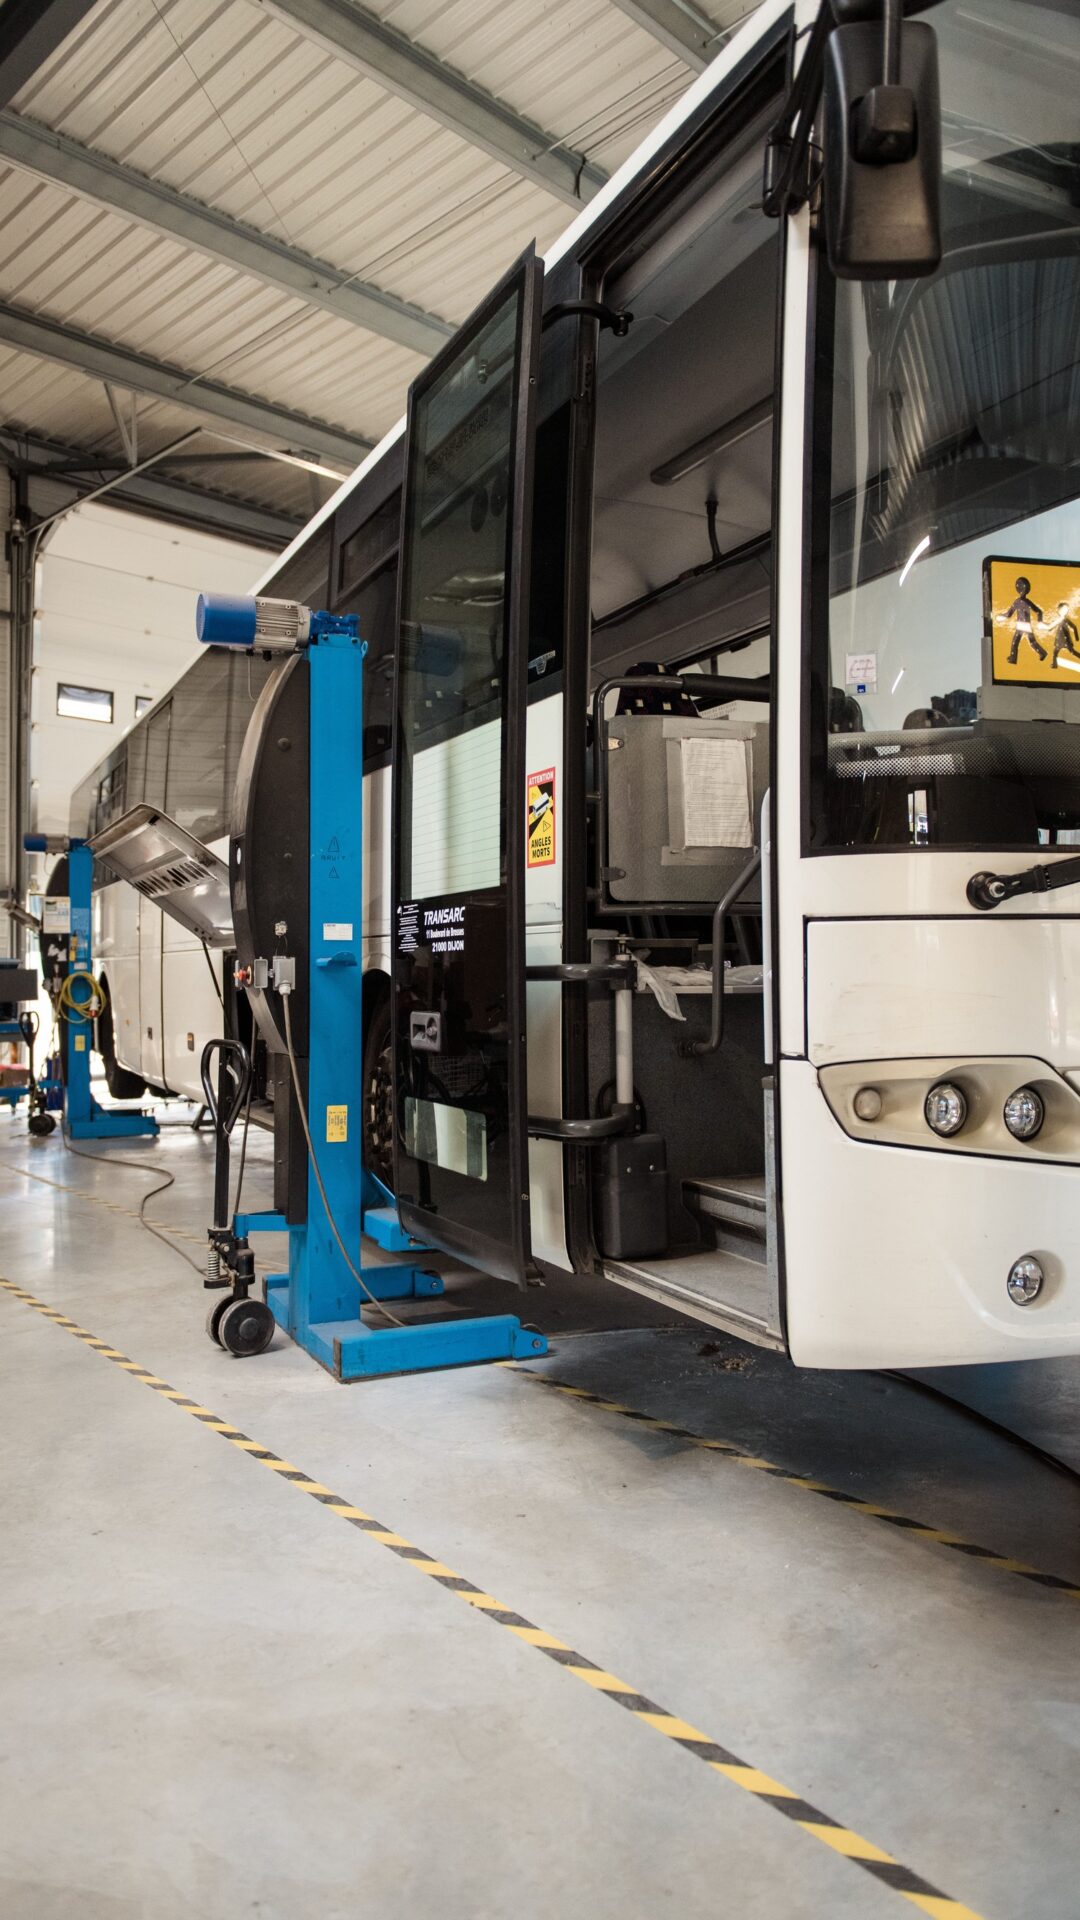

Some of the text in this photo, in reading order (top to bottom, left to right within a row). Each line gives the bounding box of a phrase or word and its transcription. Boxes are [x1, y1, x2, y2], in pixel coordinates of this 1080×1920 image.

[528, 771, 553, 785] ATTENTION
[531, 836, 551, 848] ANGLES
[532, 847, 550, 858] MORTS
[424, 906, 465, 925] TRANSARC
[432, 940, 464, 952] 21000 DIJON
